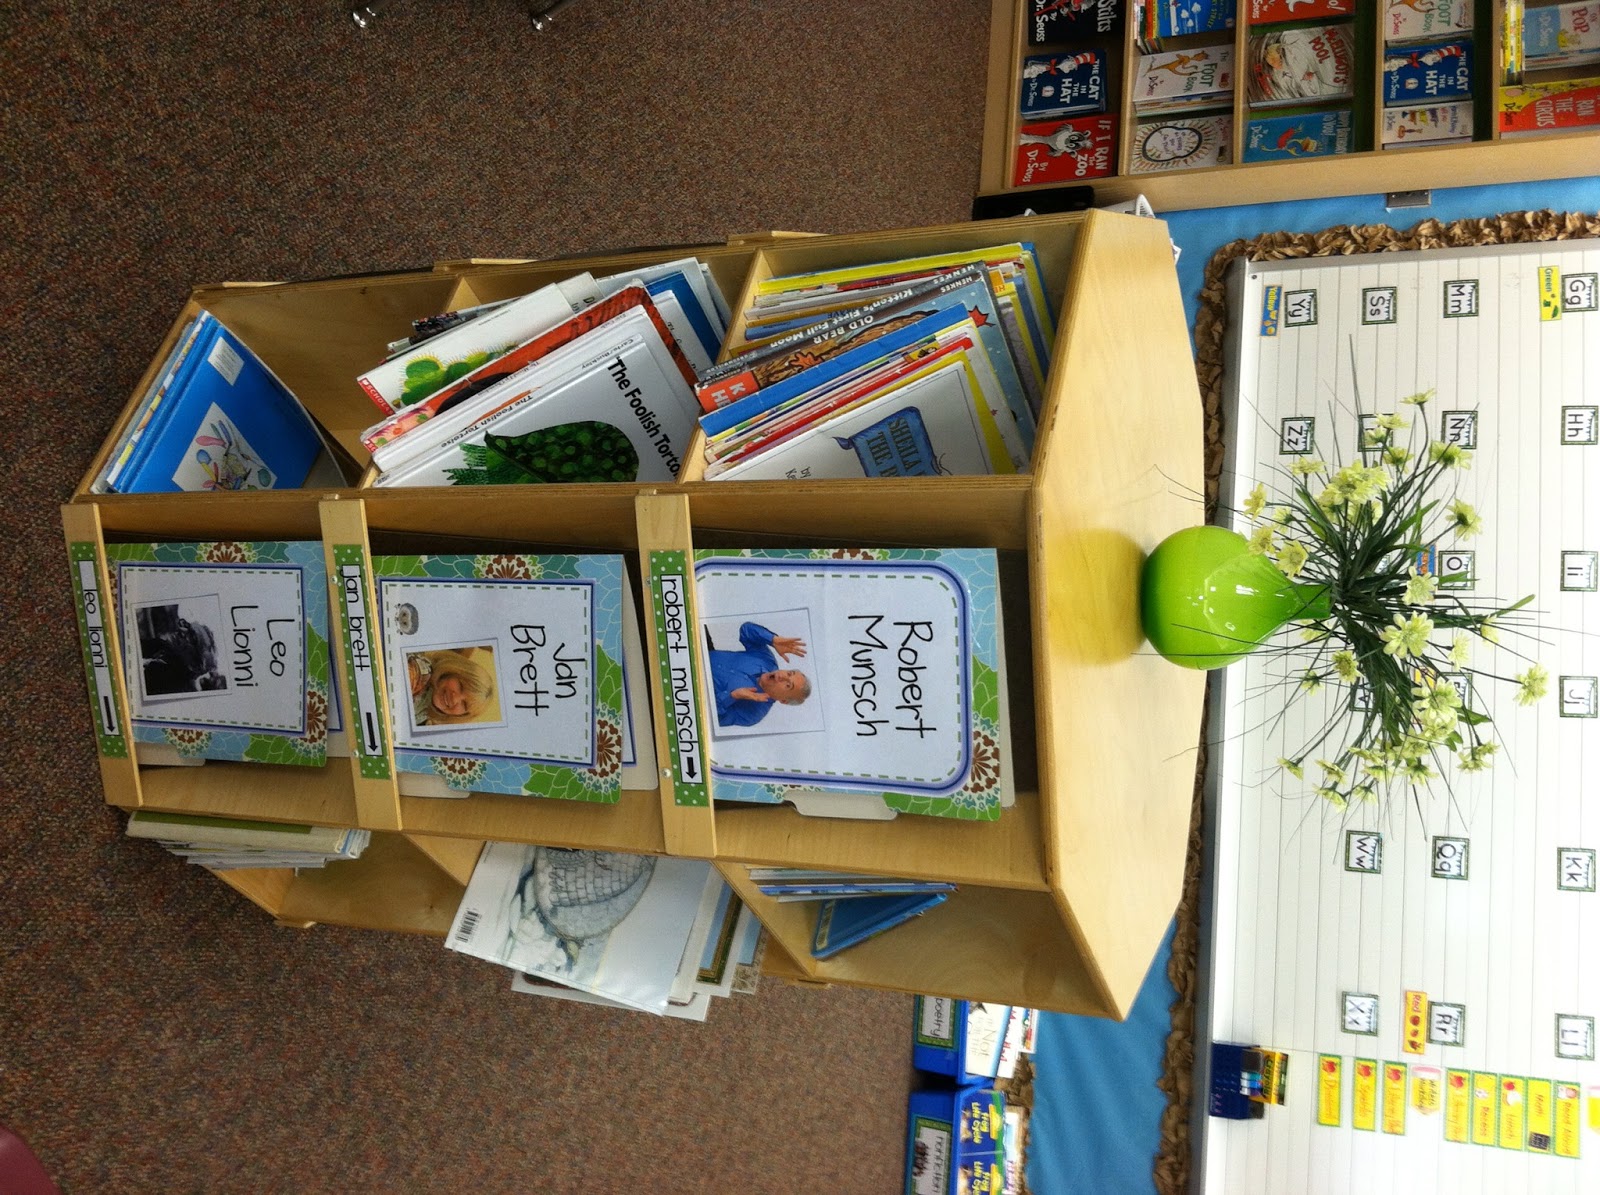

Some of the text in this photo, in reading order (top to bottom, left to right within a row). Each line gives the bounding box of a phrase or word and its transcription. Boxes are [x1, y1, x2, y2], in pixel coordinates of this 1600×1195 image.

[1035, 14, 1048, 42] Seuss
[1097, 0, 1117, 32] Stilts
[1572, 7, 1590, 33] POP
[1308, 36, 1330, 64] POOL
[1200, 63, 1218, 87] FOOT
[1425, 70, 1438, 95] HAT
[1438, 74, 1446, 88] THE
[1447, 76, 1454, 85] IN
[1456, 51, 1469, 91] THE CAT
[1060, 78, 1072, 104] HAT
[1080, 85, 1086, 94] IN
[1088, 76, 1100, 100] CAT
[1535, 100, 1555, 127] CIRCUS
[1556, 97, 1573, 113] THE
[1576, 100, 1595, 116] RAN
[1098, 120, 1112, 131] IF
[1022, 150, 1038, 182] Dr. Seuss
[1075, 154, 1088, 176] ZOO
[1094, 147, 1109, 170] RAN
[933, 264, 975, 284] HENKES
[940, 276, 974, 292] HENKES
[1544, 268, 1554, 292] Green
[1266, 287, 1278, 311] Yellow
[1450, 284, 1465, 313] Mm
[1565, 279, 1586, 306] Gg
[832, 309, 861, 325] First
[1288, 298, 1306, 318] Yy
[1370, 295, 1385, 317] Ss
[769, 331, 804, 348] Moon
[807, 321, 829, 335] Full
[813, 315, 874, 344] OLD BEAR
[607, 358, 631, 390] The
[623, 387, 661, 438] Foolish
[441, 395, 533, 448] The Foolish Tortoise
[1449, 418, 1465, 443] Nn
[1567, 413, 1584, 438] Hh
[865, 431, 894, 466] THE
[886, 417, 922, 472] SHEILA
[1287, 425, 1303, 447] Zz
[800, 466, 813, 478] by
[1566, 566, 1583, 577] Ii
[82, 588, 108, 669] leo lionni
[340, 569, 370, 672] jan brett
[230, 605, 259, 687] Lionni
[266, 618, 295, 678] Leo
[510, 624, 550, 717] Brett
[552, 643, 586, 699] Jan
[661, 578, 699, 753] robert munsch
[847, 615, 890, 737] Munsch
[892, 621, 937, 739] Robert
[1564, 688, 1585, 705] Jj
[1355, 836, 1371, 868] Ww
[1435, 843, 1457, 873] Qq
[1565, 857, 1582, 883] Kk
[930, 998, 944, 1037] poetry
[1348, 1000, 1365, 1026] Xx
[1436, 1013, 1453, 1034] Rr
[1561, 1029, 1579, 1046] Ll
[932, 1136, 944, 1194] nonfiction
